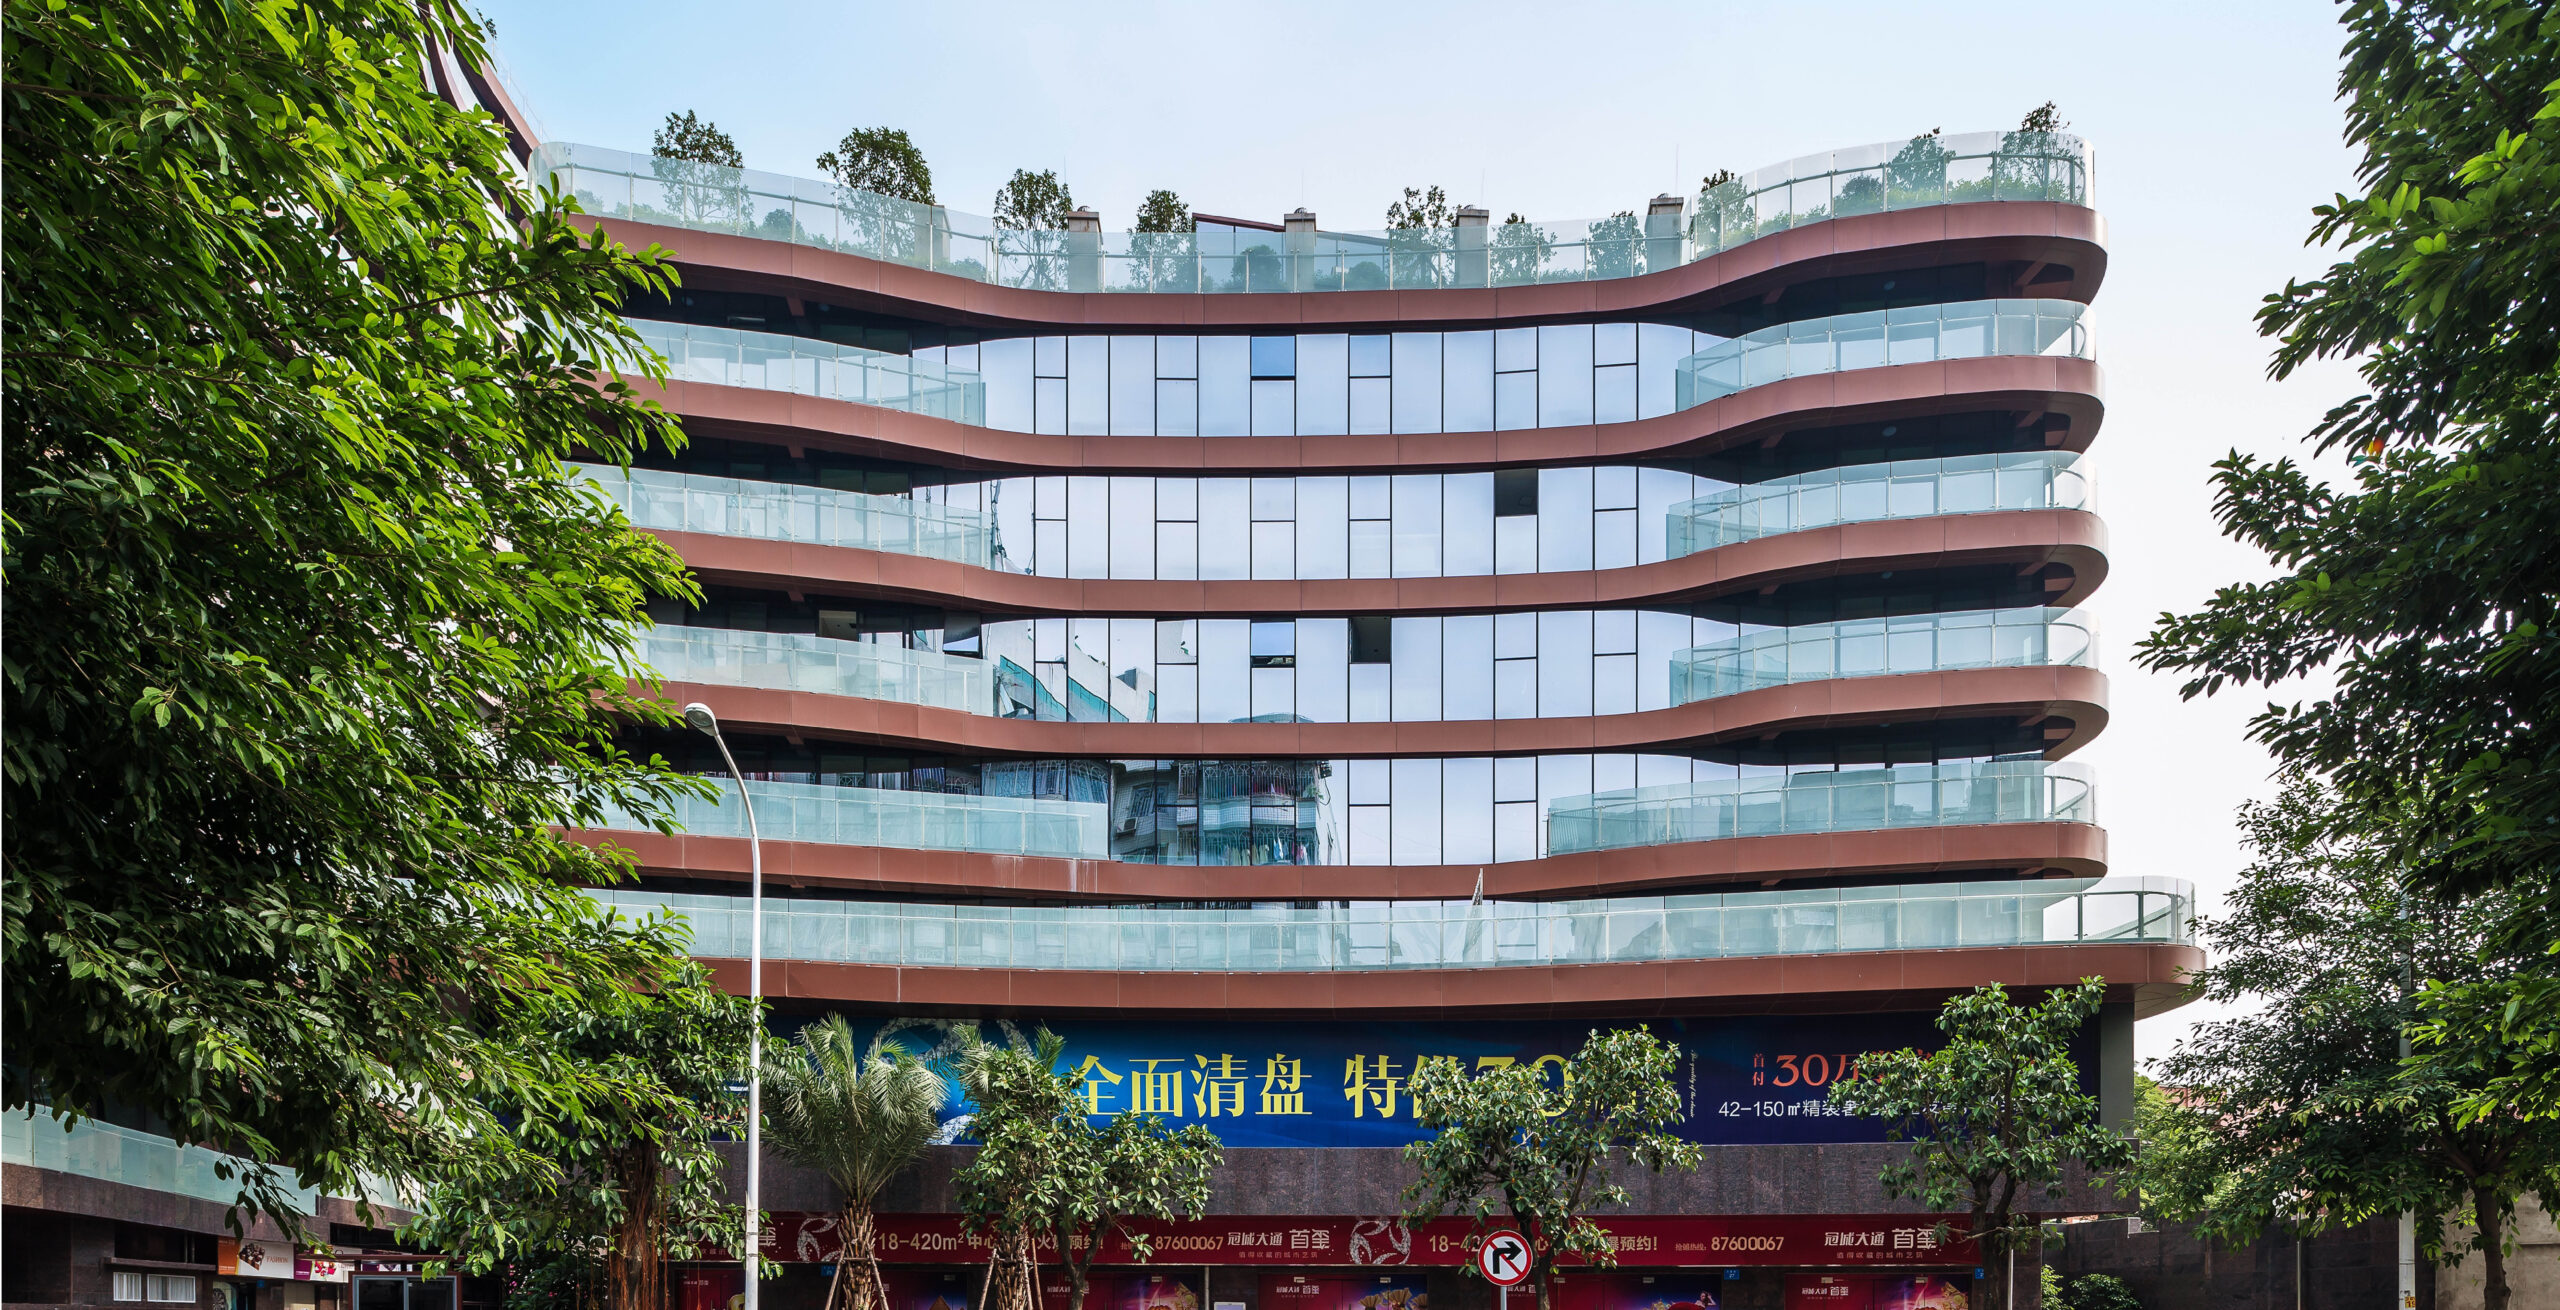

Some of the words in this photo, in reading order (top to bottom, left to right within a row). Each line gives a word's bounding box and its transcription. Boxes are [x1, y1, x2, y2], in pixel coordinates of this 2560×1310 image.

[1752, 1053, 1765, 1087] 首付
[1081, 1053, 1312, 1118] 全面清盘
[1155, 1236, 1224, 1250] 87600067
[1227, 1231, 1283, 1246] 冠城大通
[1711, 1236, 1784, 1251] 87600067
[1824, 1231, 1885, 1246] 冠城大通
